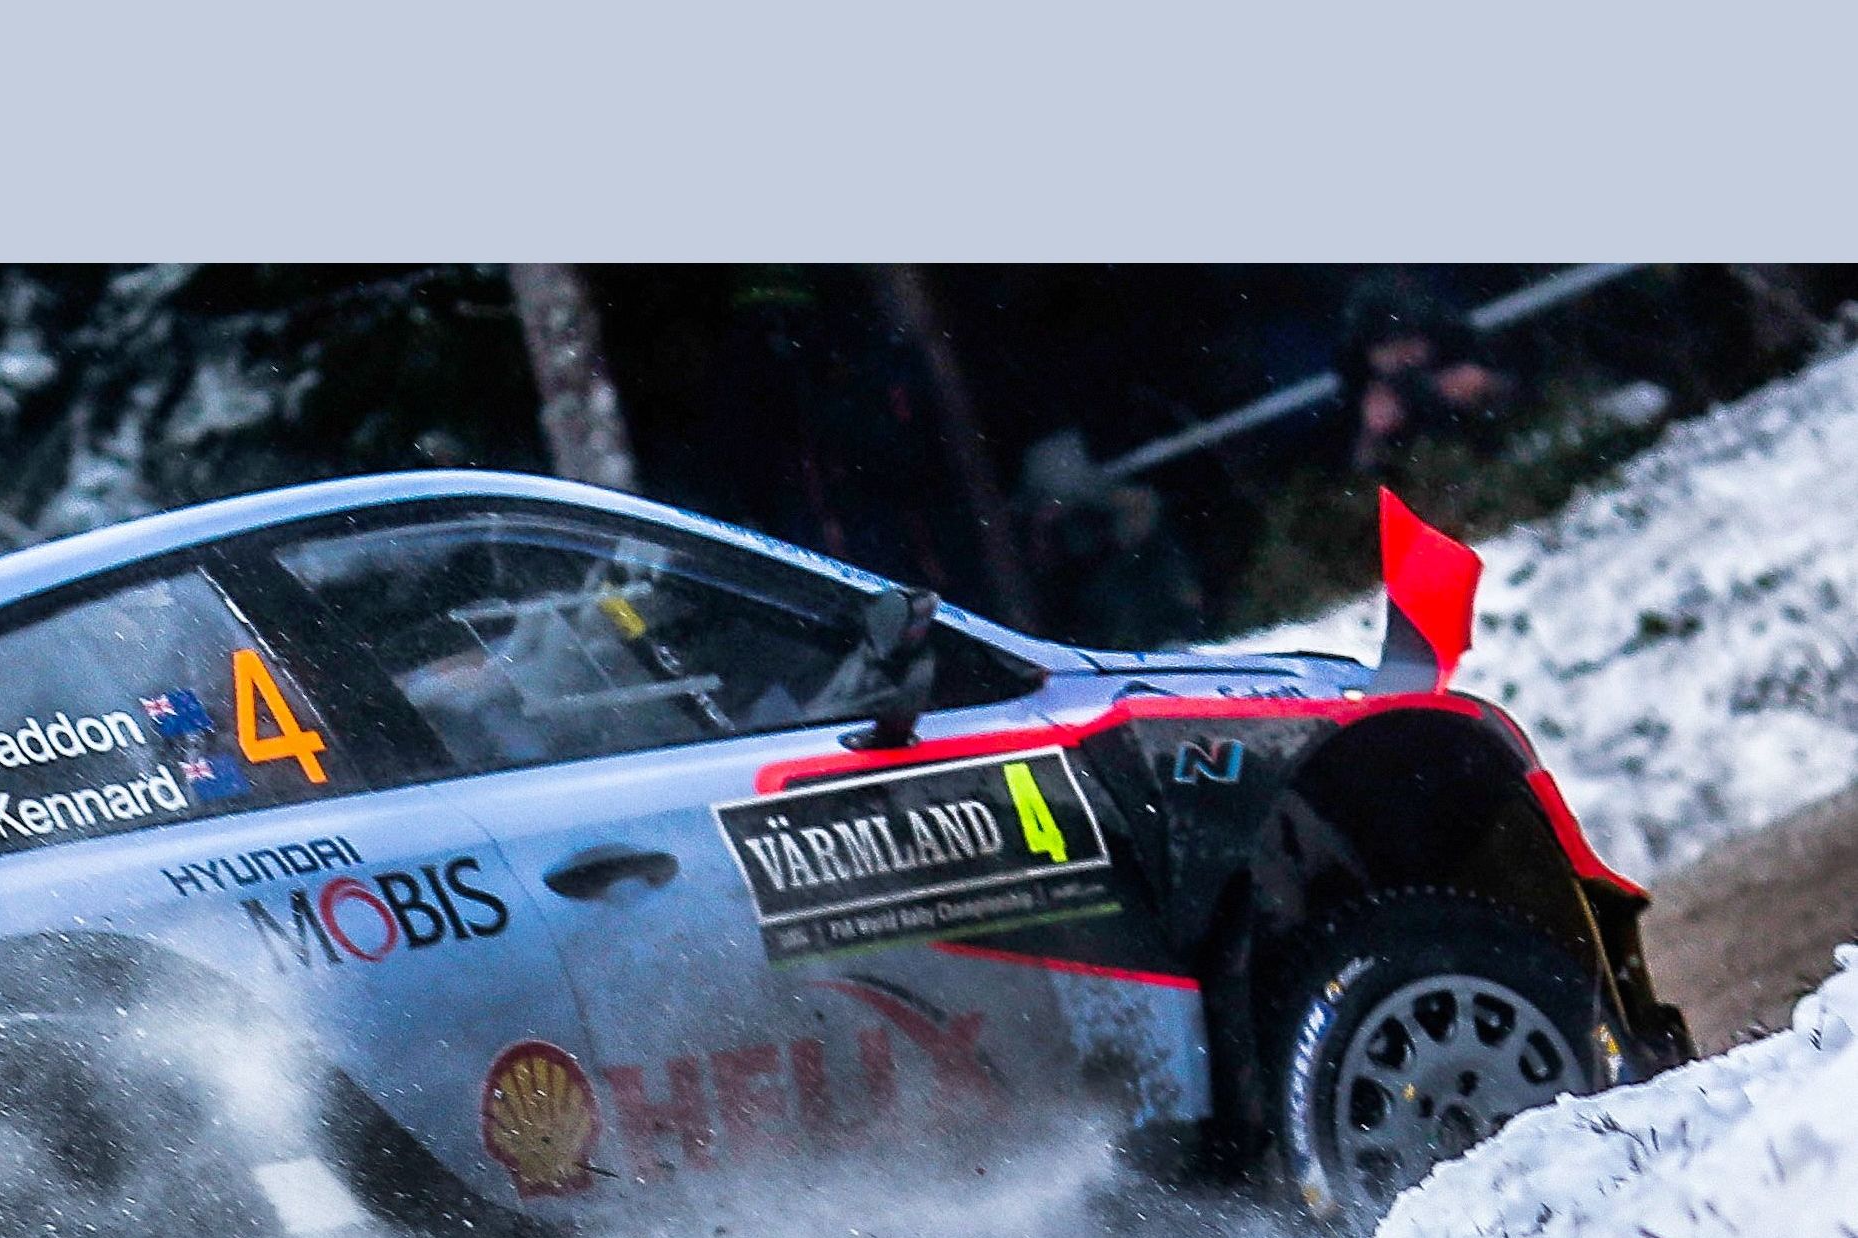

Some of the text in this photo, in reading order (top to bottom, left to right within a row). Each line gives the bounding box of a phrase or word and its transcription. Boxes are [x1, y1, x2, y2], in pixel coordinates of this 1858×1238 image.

[231, 648, 329, 785] 4
[744, 801, 1004, 891] VÄRMLAND
[1002, 762, 1069, 863] 4
[160, 834, 366, 897] HYUNDAI
[240, 856, 510, 975] MOBIS
